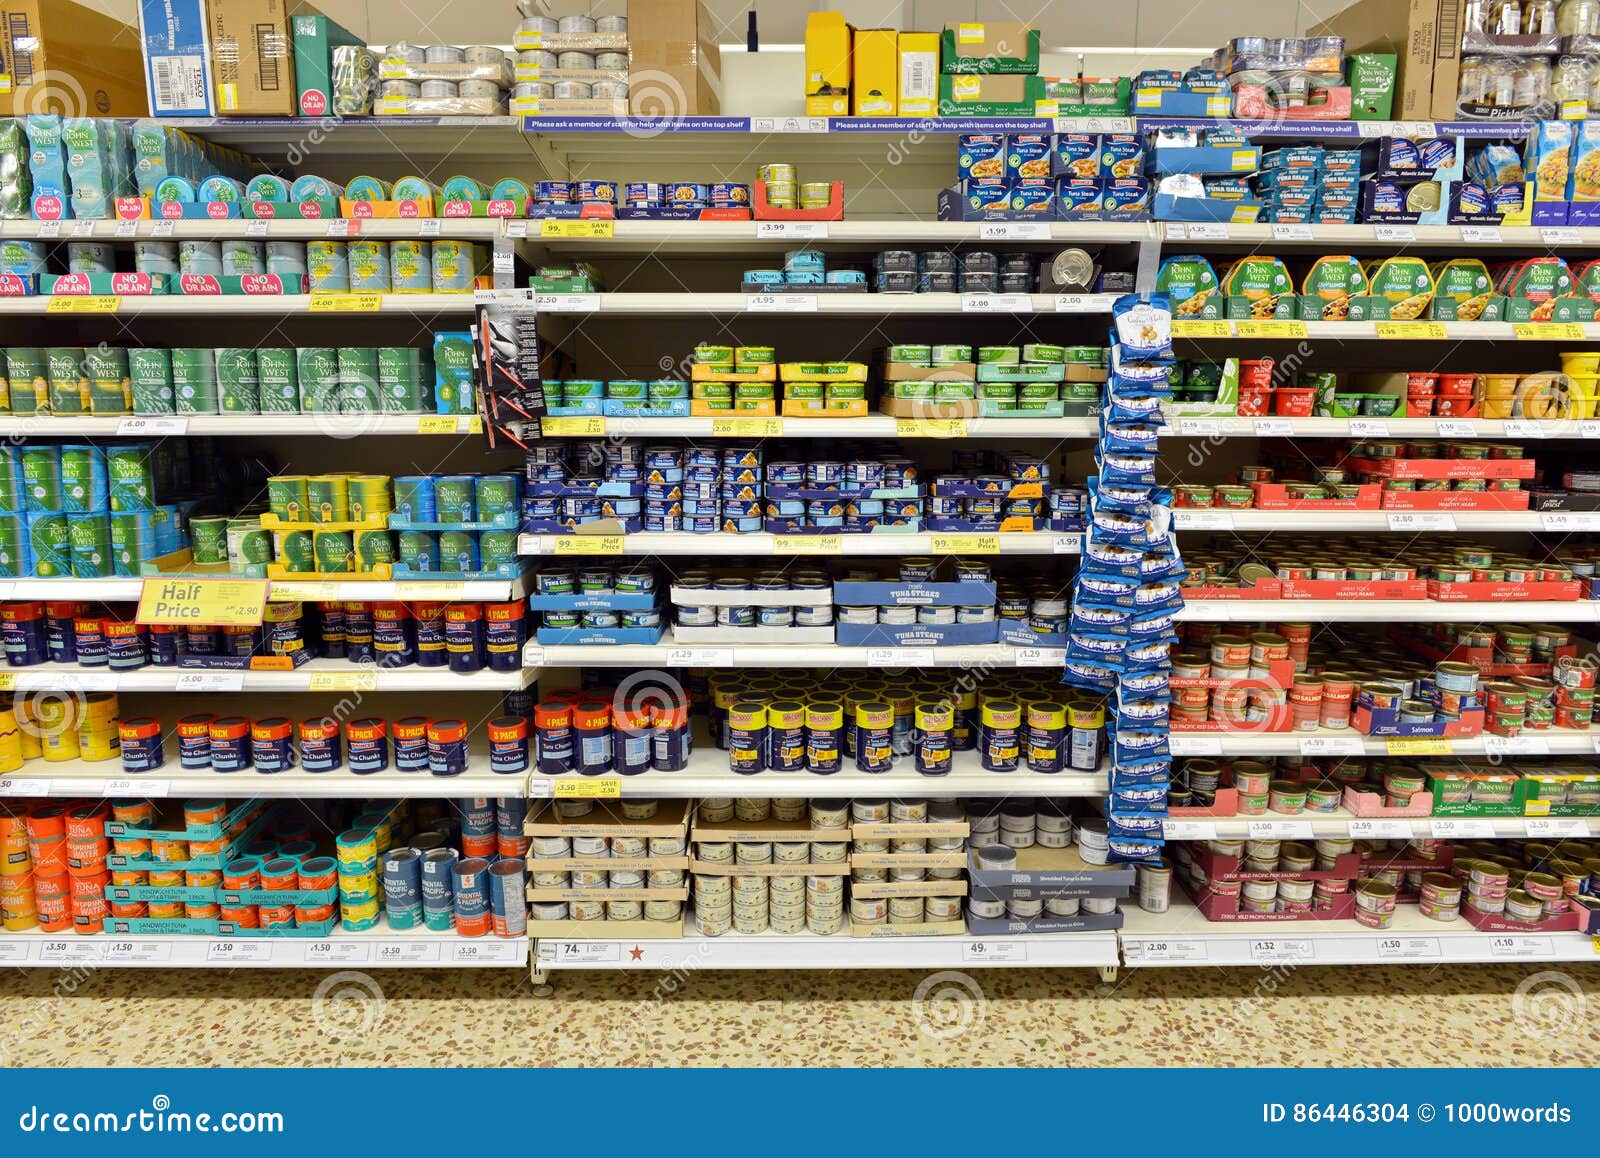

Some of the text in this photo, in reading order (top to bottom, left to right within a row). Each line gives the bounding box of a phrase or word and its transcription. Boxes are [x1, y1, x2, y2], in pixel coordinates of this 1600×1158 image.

[307, 95, 319, 103] NO
[303, 101, 325, 109] DRAIN
[639, 121, 654, 129] help
[714, 121, 726, 129] top
[942, 122, 958, 130] help
[1016, 122, 1028, 130] top
[30, 127, 52, 138] JOHN
[66, 129, 89, 140] JOHN
[34, 136, 57, 145] WEST
[71, 139, 94, 148] WEST
[36, 204, 60, 214] DRAIN
[1170, 263, 1192, 274] JOHN
[1246, 263, 1268, 274] JOHN
[1388, 264, 1410, 276] JOHN
[63, 276, 79, 284] NO
[121, 276, 138, 284] NO
[188, 276, 205, 284] NO
[1174, 273, 1195, 282] WEST
[1250, 273, 1271, 282] WEST
[1391, 274, 1412, 283] WEST
[56, 283, 88, 292] DRAIN
[116, 283, 148, 292] DRAIN
[185, 284, 217, 293] DRAIN
[444, 346, 466, 358] JOHN
[134, 357, 163, 370] JOHN
[448, 356, 469, 365] WEST
[140, 369, 166, 379] WEST
[162, 585, 202, 600] Half
[890, 590, 940, 598] TUNA STEAKS
[154, 602, 200, 618] Price
[494, 610, 510, 619] PACK
[115, 624, 136, 635] PACK
[894, 632, 944, 640] TUNA STEAKS
[551, 716, 568, 727] PACK
[499, 730, 518, 739] PACK
[504, 754, 524, 762] Chunks
